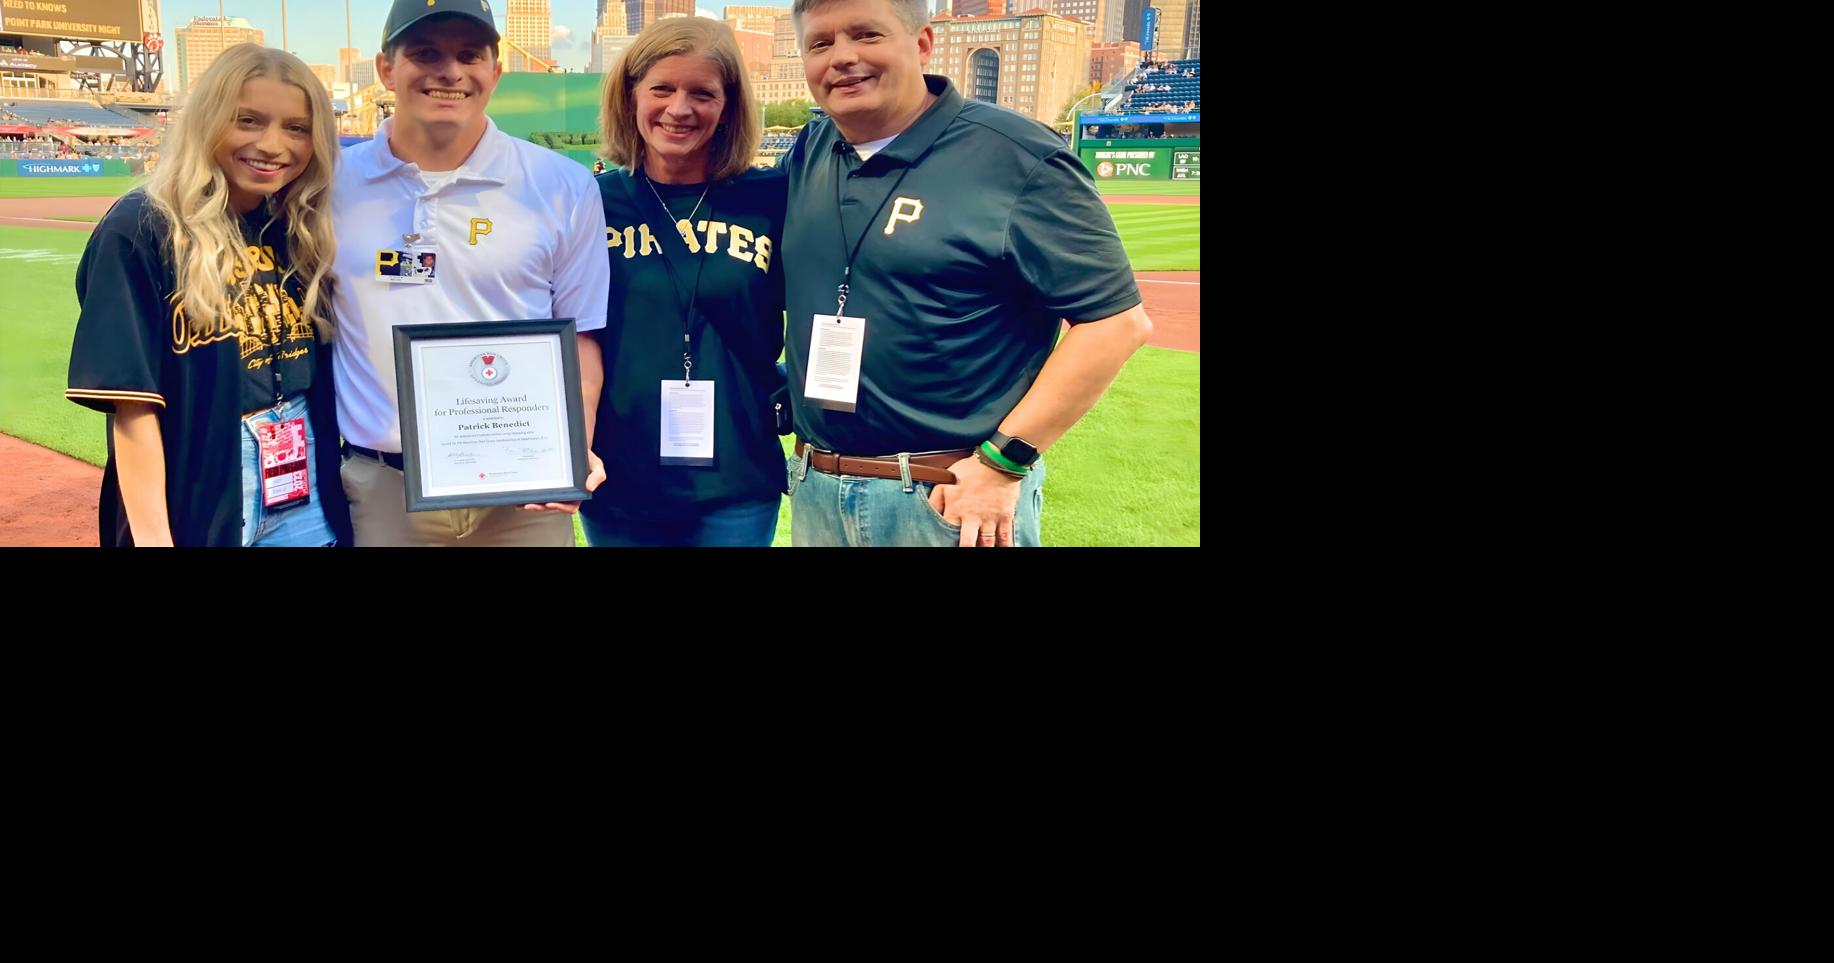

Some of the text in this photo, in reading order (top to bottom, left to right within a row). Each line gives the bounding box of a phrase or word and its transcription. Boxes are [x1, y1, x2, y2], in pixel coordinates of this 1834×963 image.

[4, 0, 67, 13] NEED TO KNOWS
[5, 17, 120, 34] POINT PARK UNIVERSITY NIGHT
[28, 163, 80, 173] HIGHMARK
[1115, 163, 1151, 176] PNC
[884, 196, 924, 235] P
[469, 217, 493, 246] P
[456, 394, 528, 406] Lifesaving Award
[434, 403, 550, 417] for Professional Responders
[458, 420, 530, 431] Patrick Benedict
